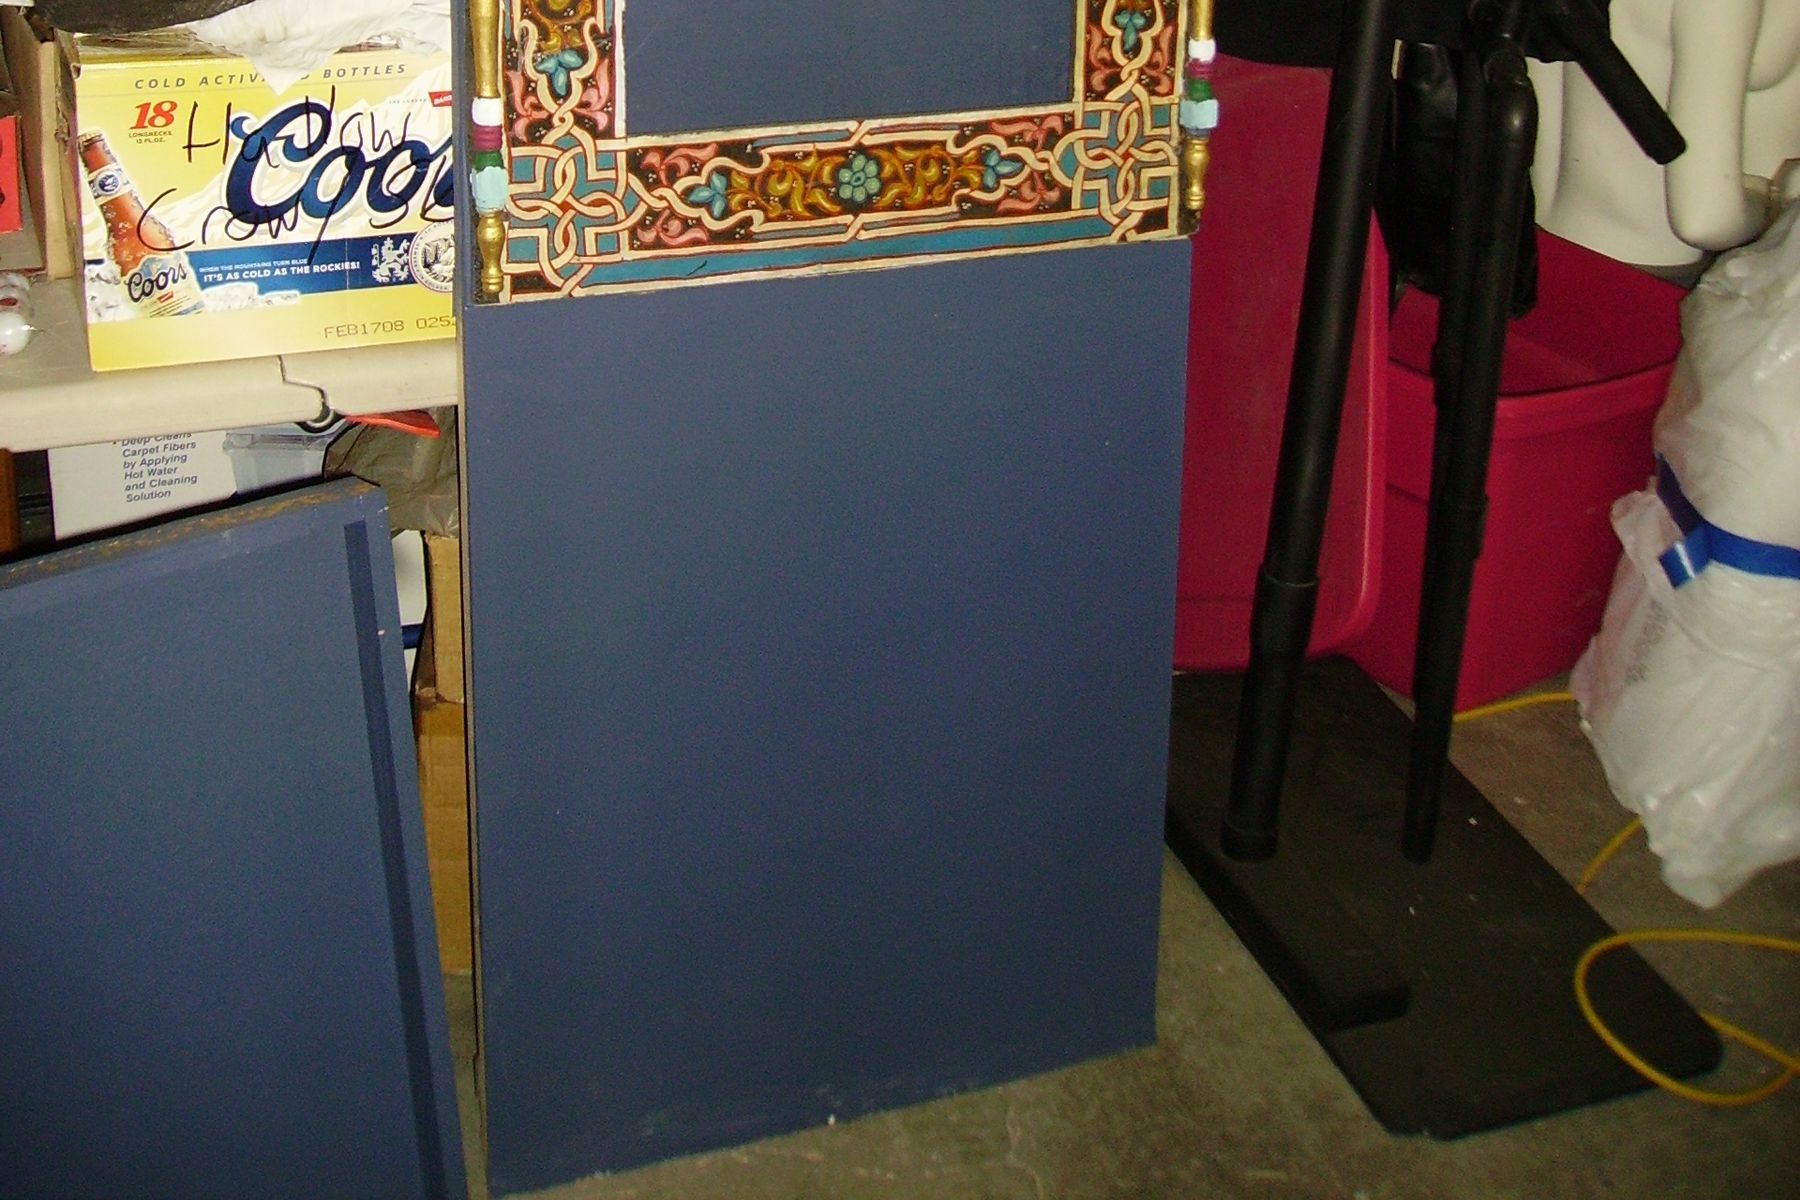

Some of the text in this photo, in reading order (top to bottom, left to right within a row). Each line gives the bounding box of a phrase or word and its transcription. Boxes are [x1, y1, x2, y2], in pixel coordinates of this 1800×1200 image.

[135, 77, 186, 89] COLD
[323, 64, 406, 79] BOTTLES
[129, 100, 178, 130] 18
[203, 261, 360, 282] IT'S AS COLD AS THE ROCKIES!
[234, 261, 272, 270] MOUNTAINS
[124, 263, 187, 303] Coors
[324, 320, 405, 339] FEB1708
[122, 441, 197, 457] Carpet Fibers
[123, 454, 188, 470] by Applying
[124, 466, 178, 480] Hot Water
[125, 475, 198, 491] and Cleaning
[126, 490, 171, 503] Solution
